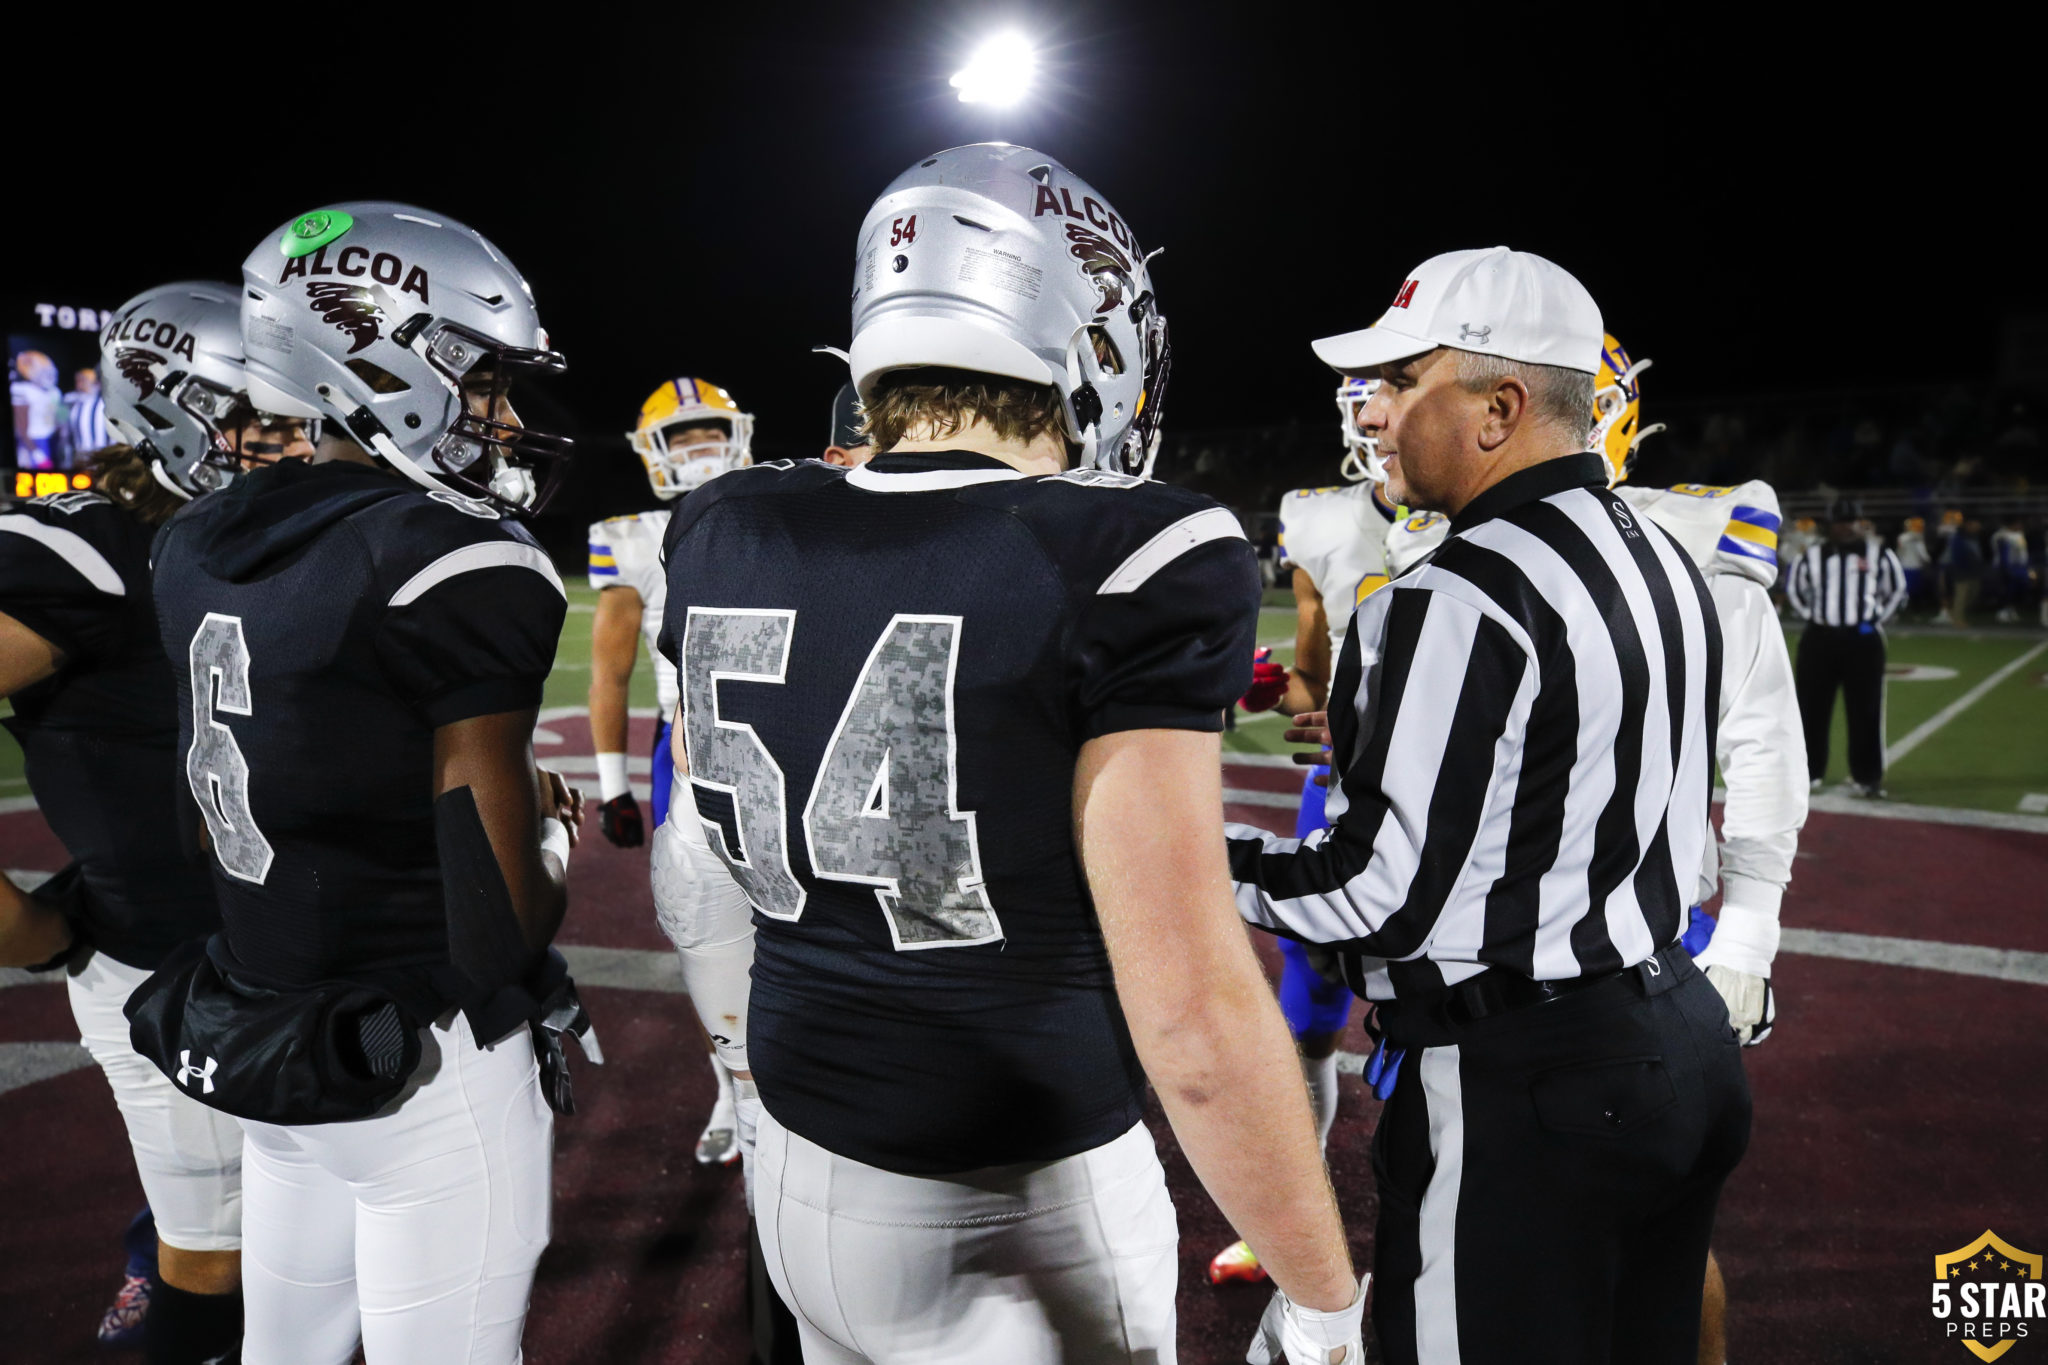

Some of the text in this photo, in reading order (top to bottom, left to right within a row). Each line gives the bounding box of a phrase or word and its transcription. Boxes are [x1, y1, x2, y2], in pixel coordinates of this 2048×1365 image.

[891, 215, 917, 247] 54
[993, 248, 1022, 262] WARNING
[1035, 185, 1142, 266] ALCOA
[279, 246, 429, 305] ALCOA
[104, 318, 195, 364] ALCOA
[187, 612, 275, 885] 6
[682, 606, 1005, 951] 54
